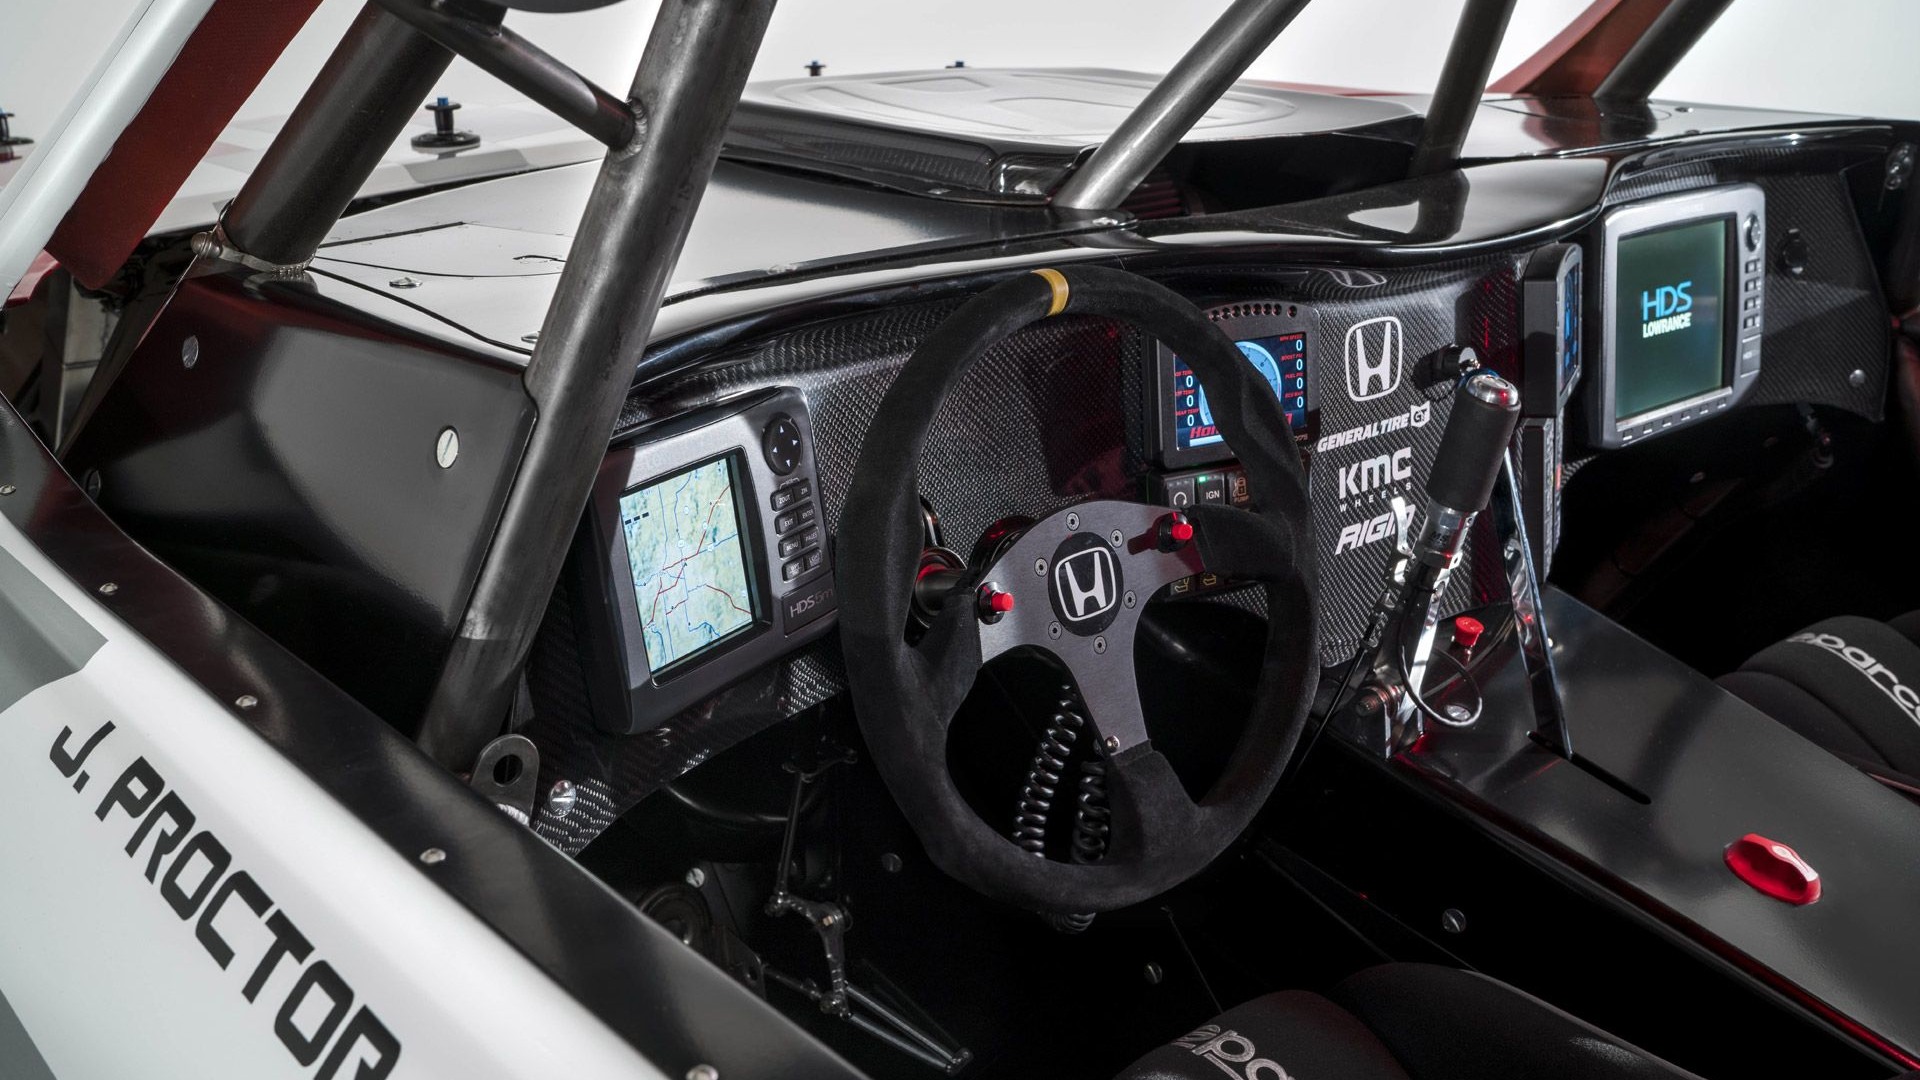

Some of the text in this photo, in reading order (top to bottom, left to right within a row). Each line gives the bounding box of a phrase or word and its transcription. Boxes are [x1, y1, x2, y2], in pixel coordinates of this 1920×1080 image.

[1643, 281, 1692, 321] HDS
[1643, 312, 1692, 338] LOWRANCE
[1295, 339, 1303, 351] 0
[1296, 359, 1303, 371] 0
[1186, 375, 1193, 388] 0
[1296, 377, 1303, 389] 0
[1186, 394, 1194, 407] 0
[1297, 396, 1304, 408] 0
[1187, 414, 1195, 427] 0
[1206, 490, 1220, 500] IGN
[1339, 482, 1412, 512] WHEELS
[1786, 632, 1920, 726] sparc
[49, 720, 402, 1080] J. PROCTOR
